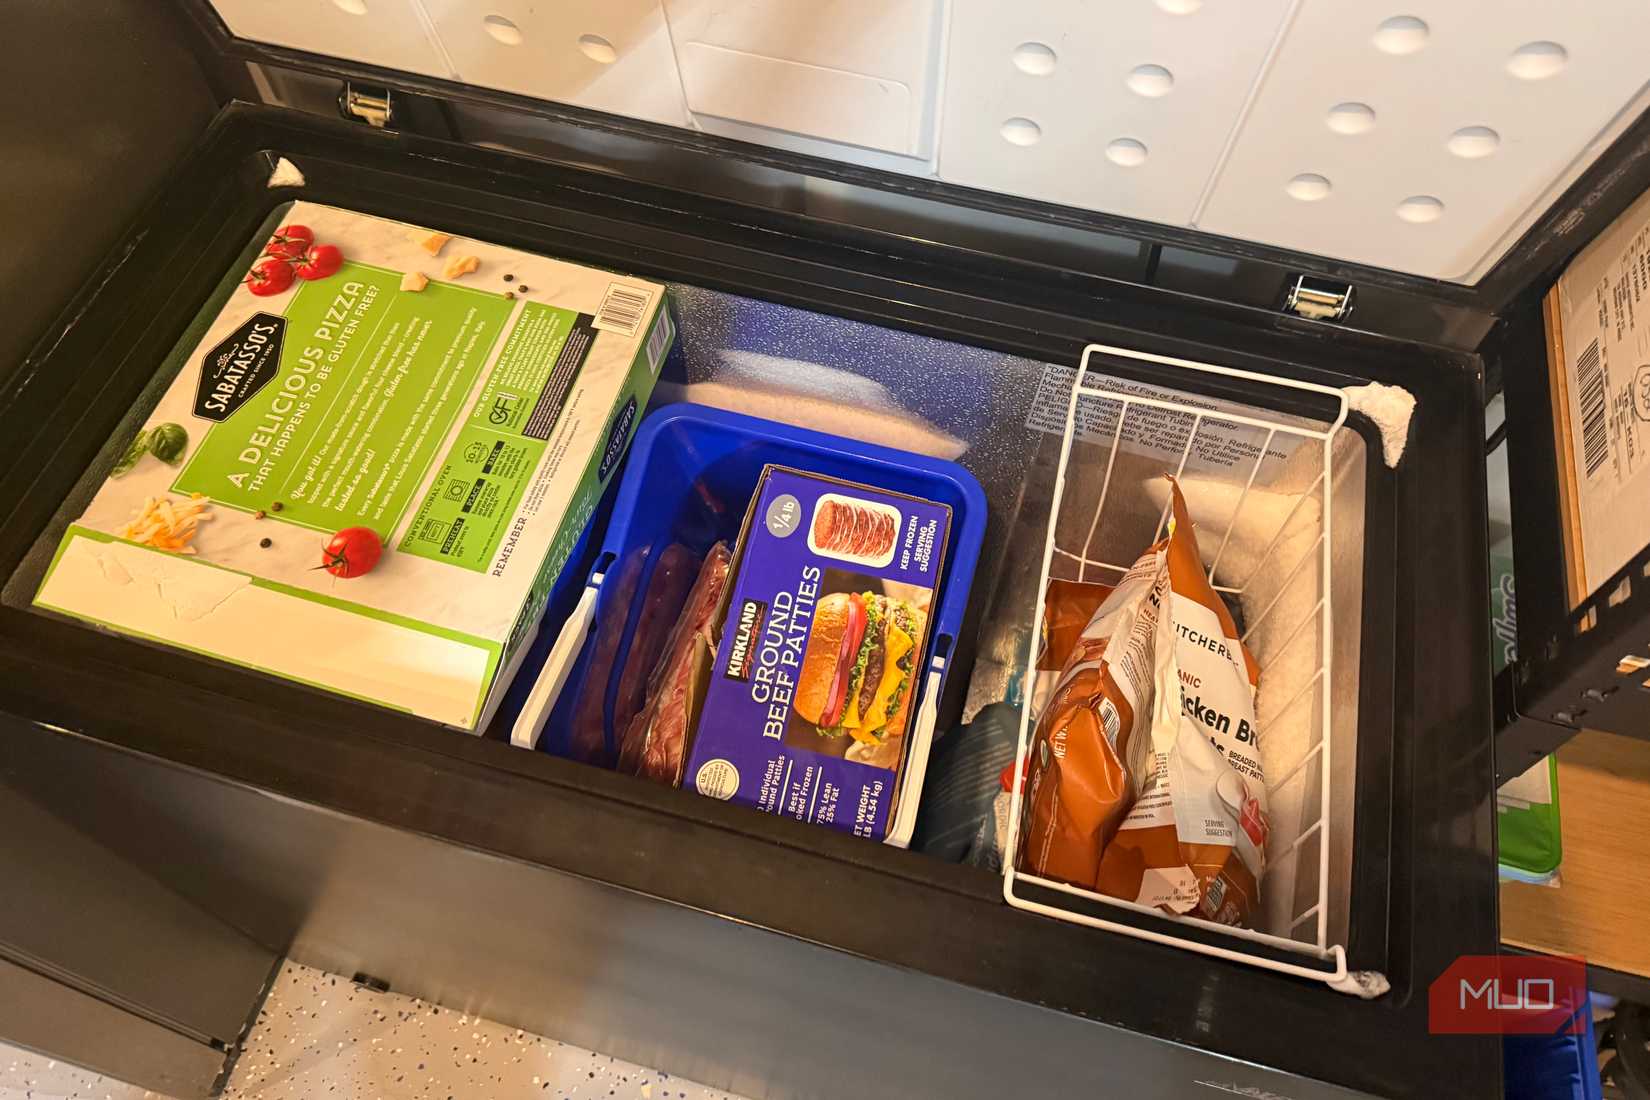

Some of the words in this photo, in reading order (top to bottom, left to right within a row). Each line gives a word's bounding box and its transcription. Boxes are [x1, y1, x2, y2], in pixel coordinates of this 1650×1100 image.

[312, 279, 366, 341] PIZZA
[237, 373, 257, 398] CRAFTED
[252, 357, 266, 372] SINCE
[473, 402, 485, 417] OUR
[481, 355, 509, 400] GLUTEN-FREE
[504, 308, 532, 354] COMMITMENT
[236, 344, 327, 463] DELICIOUS
[246, 458, 277, 492] THAT
[268, 401, 312, 456] HAPPENS
[303, 382, 323, 399] TO
[315, 365, 333, 379] BE
[325, 318, 362, 362] GLUTEN
[352, 284, 381, 316] FREE?
[1140, 386, 1157, 396] Fire
[1040, 386, 1053, 394] Do
[1078, 395, 1114, 408] uncture
[1116, 403, 1167, 421] Rfrigerant
[1169, 416, 1195, 428] Tubin
[1029, 419, 1082, 435] Refrigerte
[1031, 412, 1084, 429] Dispositos
[1155, 442, 1185, 454] Perfor
[1036, 400, 1081, 415] Inflamae
[1204, 442, 1221, 450] por
[1048, 408, 1083, 421] Servio
[1085, 420, 1136, 436] Capacdo
[1149, 434, 1188, 448] Formad
[1212, 449, 1240, 461] Utilice
[1142, 417, 1168, 430] fuego
[1228, 439, 1288, 460] Refrigeante
[354, 448, 380, 473] good!
[464, 441, 482, 463] 10-15
[223, 468, 250, 487] A
[289, 480, 312, 500] You
[301, 466, 320, 481] got
[350, 472, 363, 485] so
[332, 484, 356, 511] tasted
[403, 486, 441, 547] CONVENTIONAL
[435, 464, 452, 485] OVEN
[442, 519, 463, 552] PREHEAT
[492, 516, 528, 577] REMEMBER
[900, 549, 911, 571] KEEP
[906, 515, 919, 548] FROZEN
[914, 526, 928, 562] SERVING
[920, 519, 938, 573] SUGGESTION
[727, 601, 757, 678] KIRKLAND
[752, 591, 793, 704] GROUND
[763, 671, 795, 741] BEEF
[781, 565, 821, 668] PATTIES
[1054, 742, 1066, 758] NET
[1228, 749, 1257, 769] BREADED
[758, 760, 776, 804] Individual
[772, 755, 785, 786] Patties
[800, 766, 814, 796] Frozen
[788, 792, 799, 813] Best
[821, 782, 833, 804] Lean
[830, 787, 840, 803] Fat
[856, 784, 872, 823] WEIGHT
[870, 781, 884, 800] kg)
[825, 803, 837, 823] 25%
[866, 799, 878, 825] (4.54
[1204, 819, 1225, 829] SERVING
[863, 826, 873, 838] LB
[1205, 828, 1233, 837] SUGGESTION
